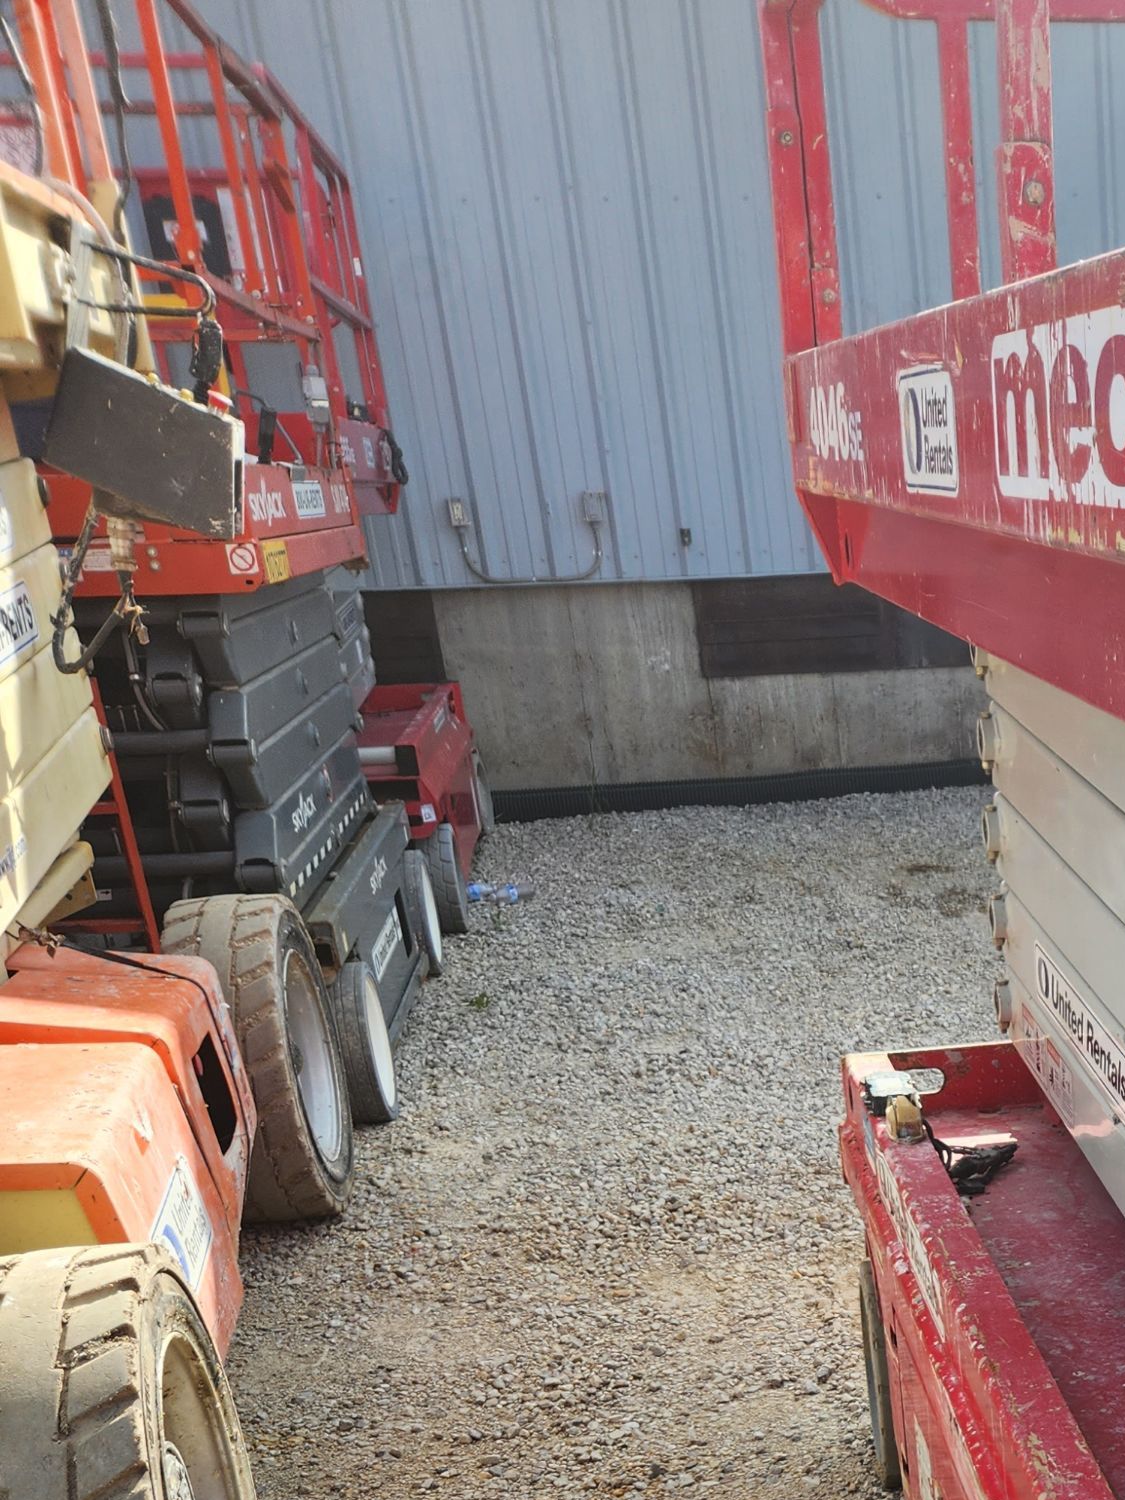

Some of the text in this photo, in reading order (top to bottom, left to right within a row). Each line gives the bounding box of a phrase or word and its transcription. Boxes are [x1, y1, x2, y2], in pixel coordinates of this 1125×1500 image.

[921, 385, 947, 428] United
[924, 434, 953, 475] Rentals
[1052, 973, 1084, 1046] United
